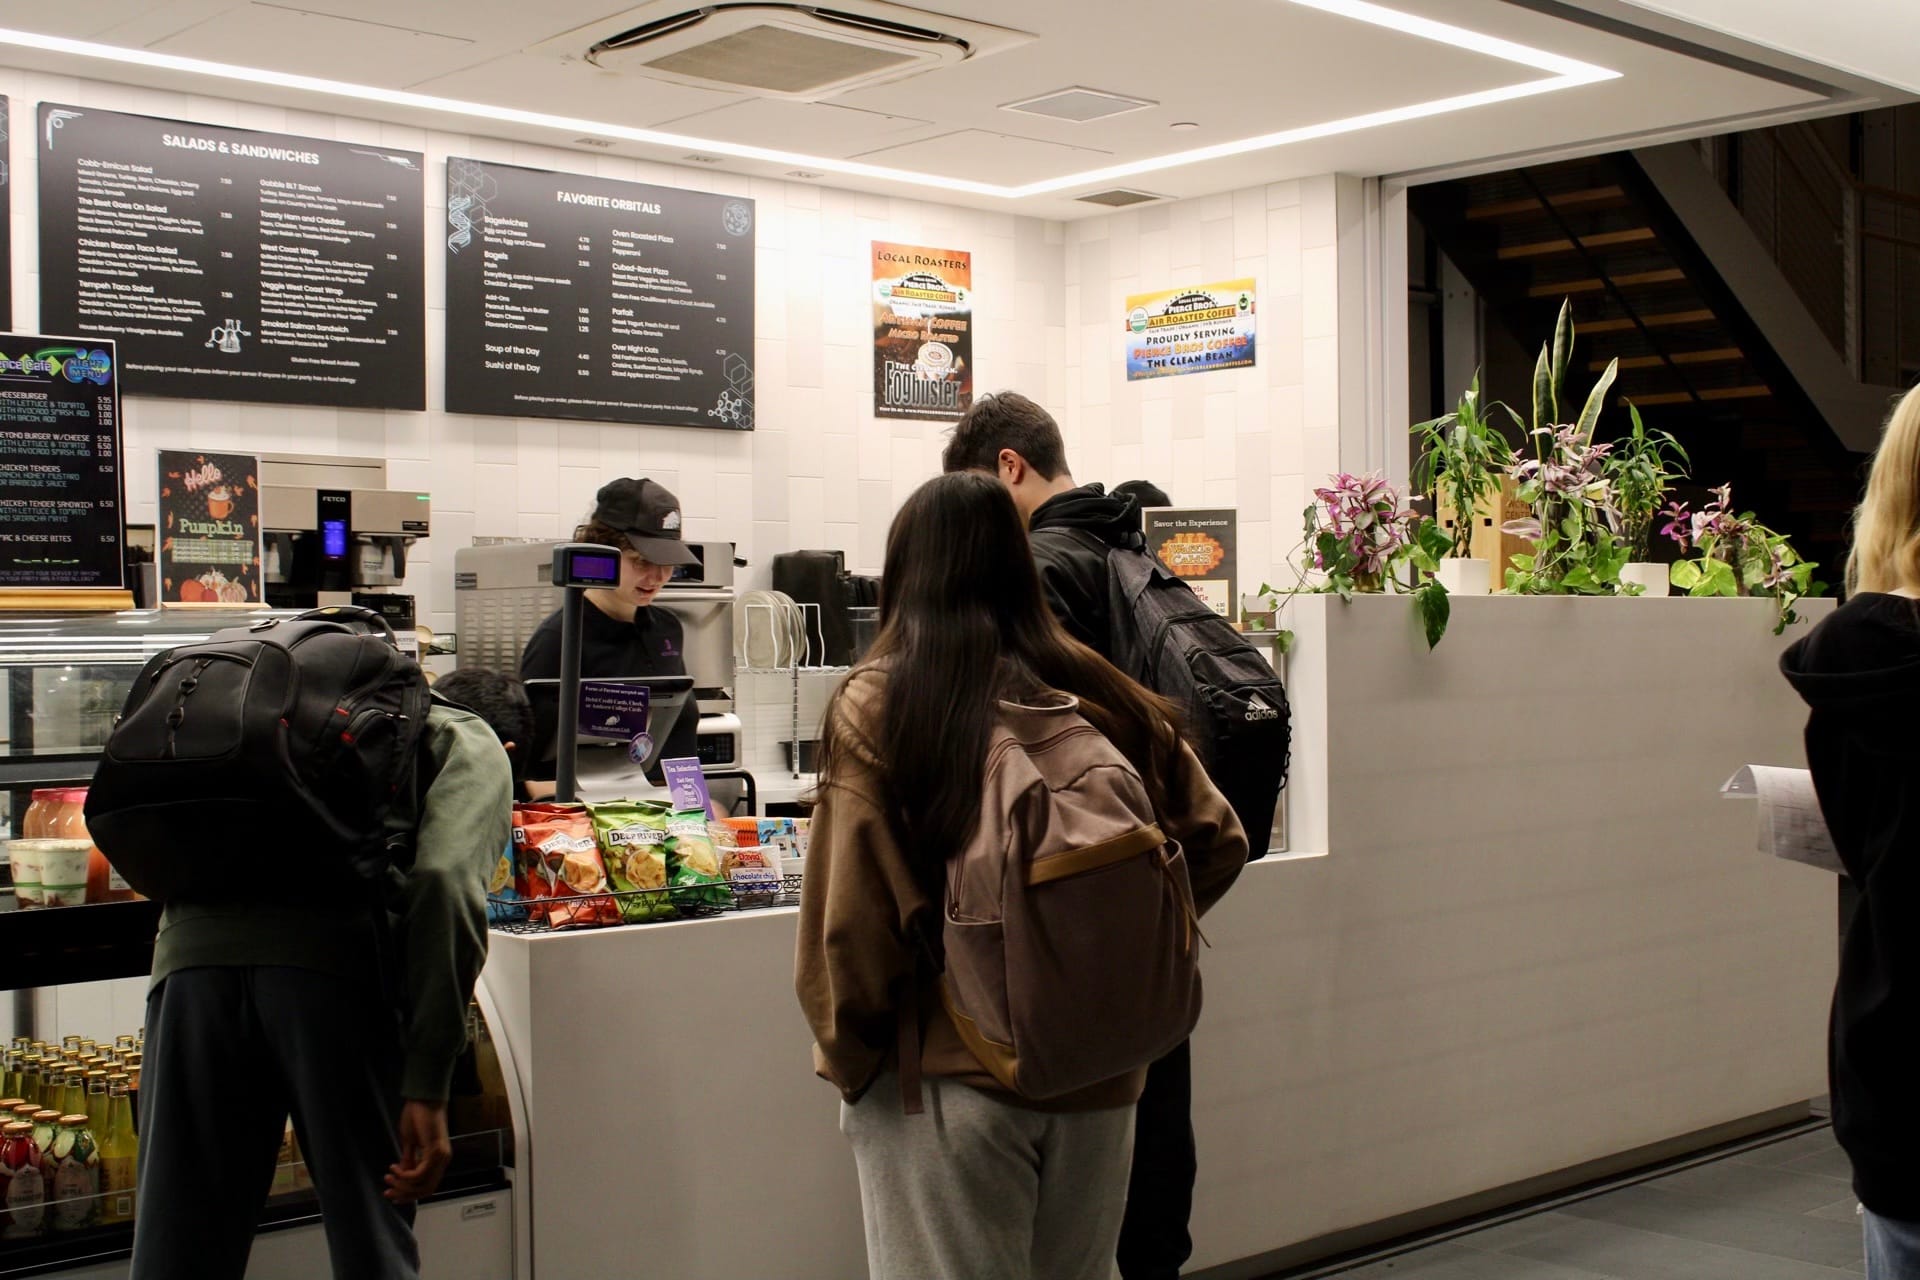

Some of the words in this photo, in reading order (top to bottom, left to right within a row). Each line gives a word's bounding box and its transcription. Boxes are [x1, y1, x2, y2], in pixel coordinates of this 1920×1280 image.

[163, 134, 216, 152] SALADS
[218, 141, 229, 153] &
[232, 143, 319, 164] SANDWICHES
[132, 165, 152, 174] Salad
[286, 182, 297, 190] BLT
[298, 184, 322, 192] Smash
[78, 197, 93, 206] The
[112, 201, 132, 210] Goes
[133, 202, 144, 210] On
[146, 204, 167, 213] Salad
[557, 191, 610, 208] FAVORITE
[611, 197, 661, 214] ORBITALS
[260, 210, 283, 220] Toasty
[284, 213, 300, 221] Ham
[316, 216, 345, 226] Cheddar
[612, 229, 630, 238] Oven
[631, 232, 657, 241] Roasted
[658, 235, 674, 243] Pizza
[78, 238, 110, 248] Chicken
[111, 241, 135, 250] Bacon
[136, 244, 155, 252] Taco
[156, 246, 178, 255] Salad
[260, 244, 277, 252] West
[279, 245, 299, 254] Coast
[300, 247, 319, 257] Wrap
[484, 251, 508, 260] Bagels
[878, 251, 911, 264] LOCAL
[914, 254, 967, 270] ROASTERS
[612, 263, 652, 274] Cubed-Root
[78, 280, 111, 290] Tempeh
[112, 283, 131, 291] Taco
[132, 284, 154, 293] Salad
[260, 282, 285, 291] Veggie
[286, 283, 303, 291] West
[304, 285, 324, 293] Coast
[325, 286, 343, 296] Wrap
[906, 289, 933, 300] ROASTED
[935, 292, 956, 302] COFFEE
[612, 308, 634, 316] Parfait
[1168, 304, 1193, 313] PIERCE
[1150, 318, 1164, 326] AIR
[1166, 312, 1204, 323] ROASTED
[1206, 308, 1236, 318] COFFEE
[261, 320, 289, 329] Smoked
[290, 322, 315, 330] Salmon
[317, 324, 349, 333] Sandwich
[931, 317, 967, 331] COFFEE
[1146, 333, 1190, 345] PROUDLY
[1194, 327, 1235, 340] SERVING
[485, 344, 503, 353] Soup
[513, 346, 524, 354] the
[526, 347, 540, 357] Day
[628, 345, 643, 353] Night
[645, 346, 659, 354] Oats
[1133, 347, 1171, 360] PIERCE
[1174, 343, 1203, 354] BROS
[1207, 336, 1248, 350] COFFEE
[70, 360, 103, 368] NIGHT
[1147, 358, 1166, 369] THE
[1170, 355, 1201, 366] CLEAN
[1206, 351, 1233, 362] BEAN
[485, 361, 504, 369] Sushi
[505, 362, 512, 370] of
[527, 364, 540, 374] Day
[98, 396, 111, 404] 5.95
[0, 464, 28, 472] CHICKEN
[99, 465, 113, 473] 6.50
[184, 462, 222, 492] Hello
[179, 518, 244, 537] Pumpkin
[1154, 520, 1173, 528] Savor
[1189, 519, 1228, 528] Experience
[1245, 710, 1278, 720] adidas
[611, 833, 636, 842] DEEP
[637, 833, 664, 841] RIVER
[763, 872, 775, 880] chip
